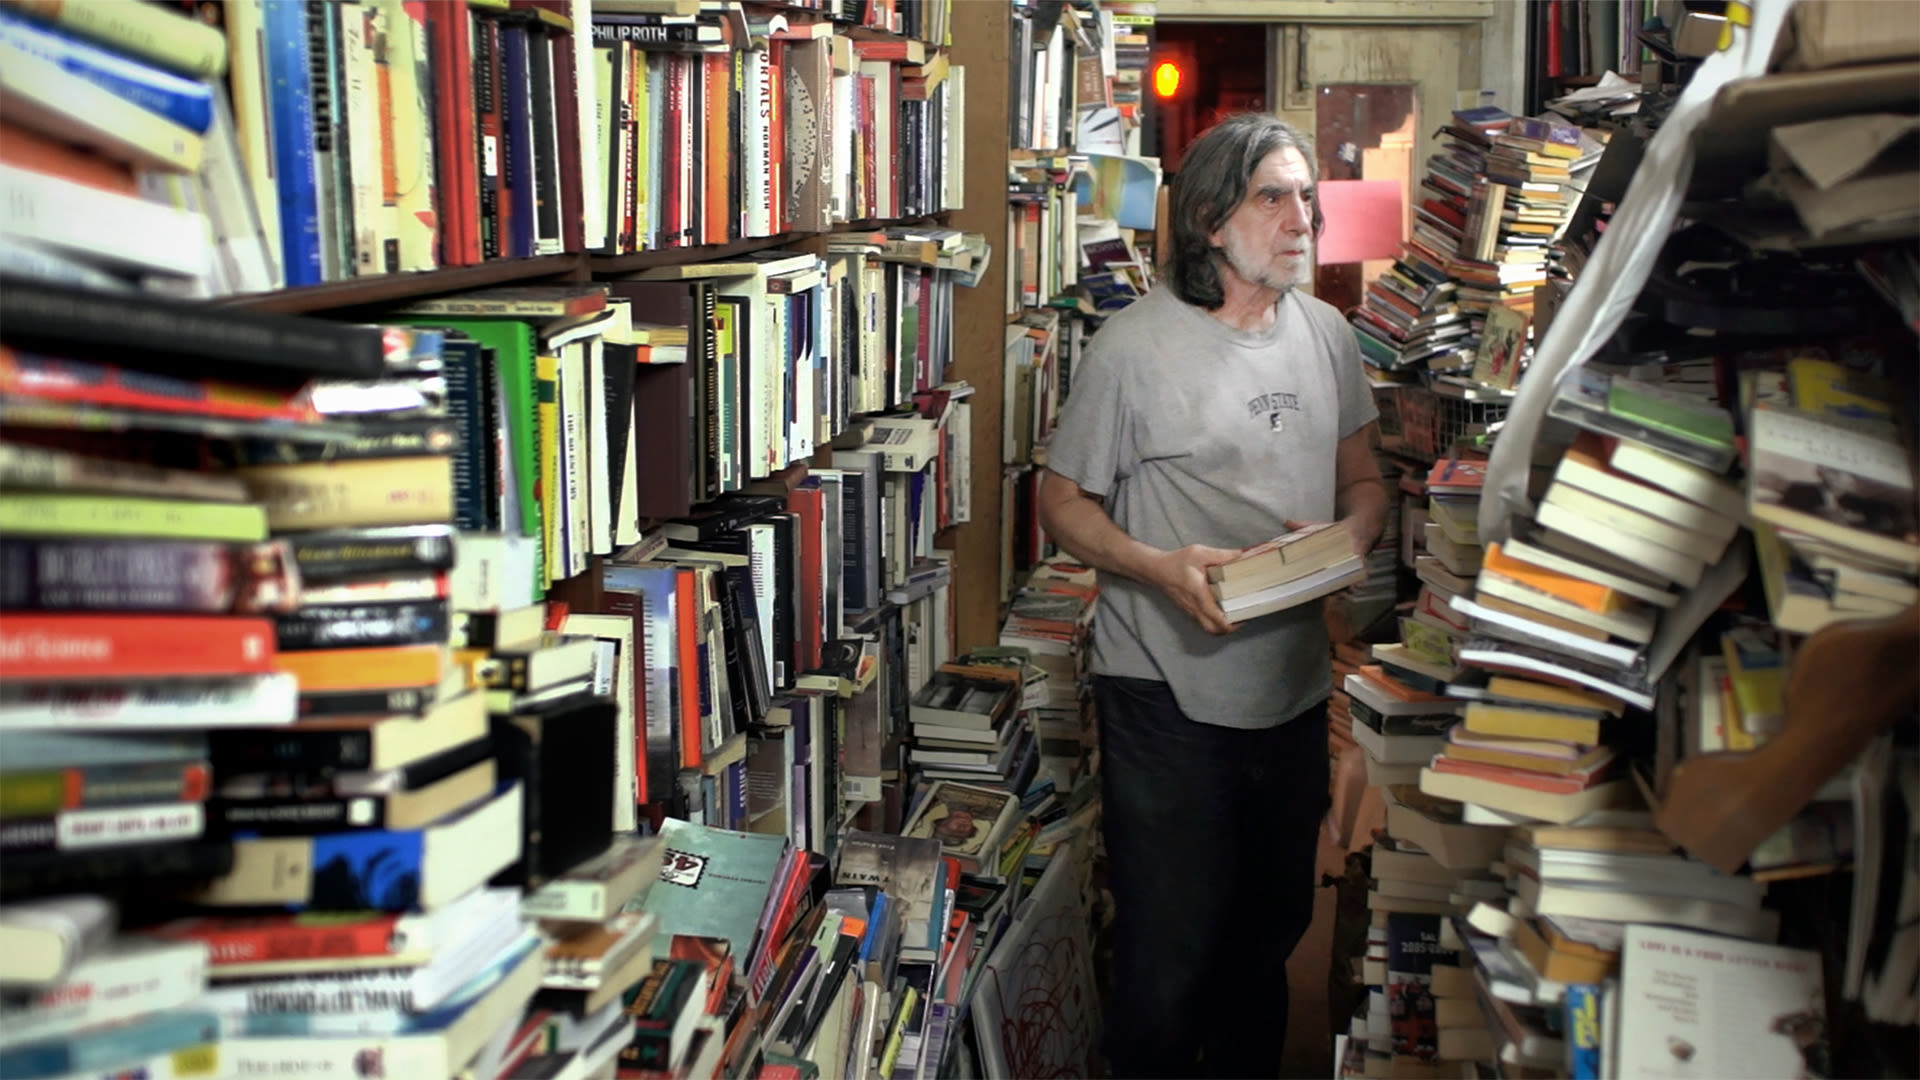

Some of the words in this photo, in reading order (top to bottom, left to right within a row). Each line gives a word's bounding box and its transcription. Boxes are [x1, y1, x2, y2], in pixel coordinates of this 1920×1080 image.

[591, 25, 630, 41] PHILIP
[632, 26, 668, 42] ROTH
[759, 52, 770, 119] ORTALS
[762, 124, 770, 174] NORMAN
[1271, 392, 1301, 412] STATE
[841, 871, 890, 884] TWAIN
